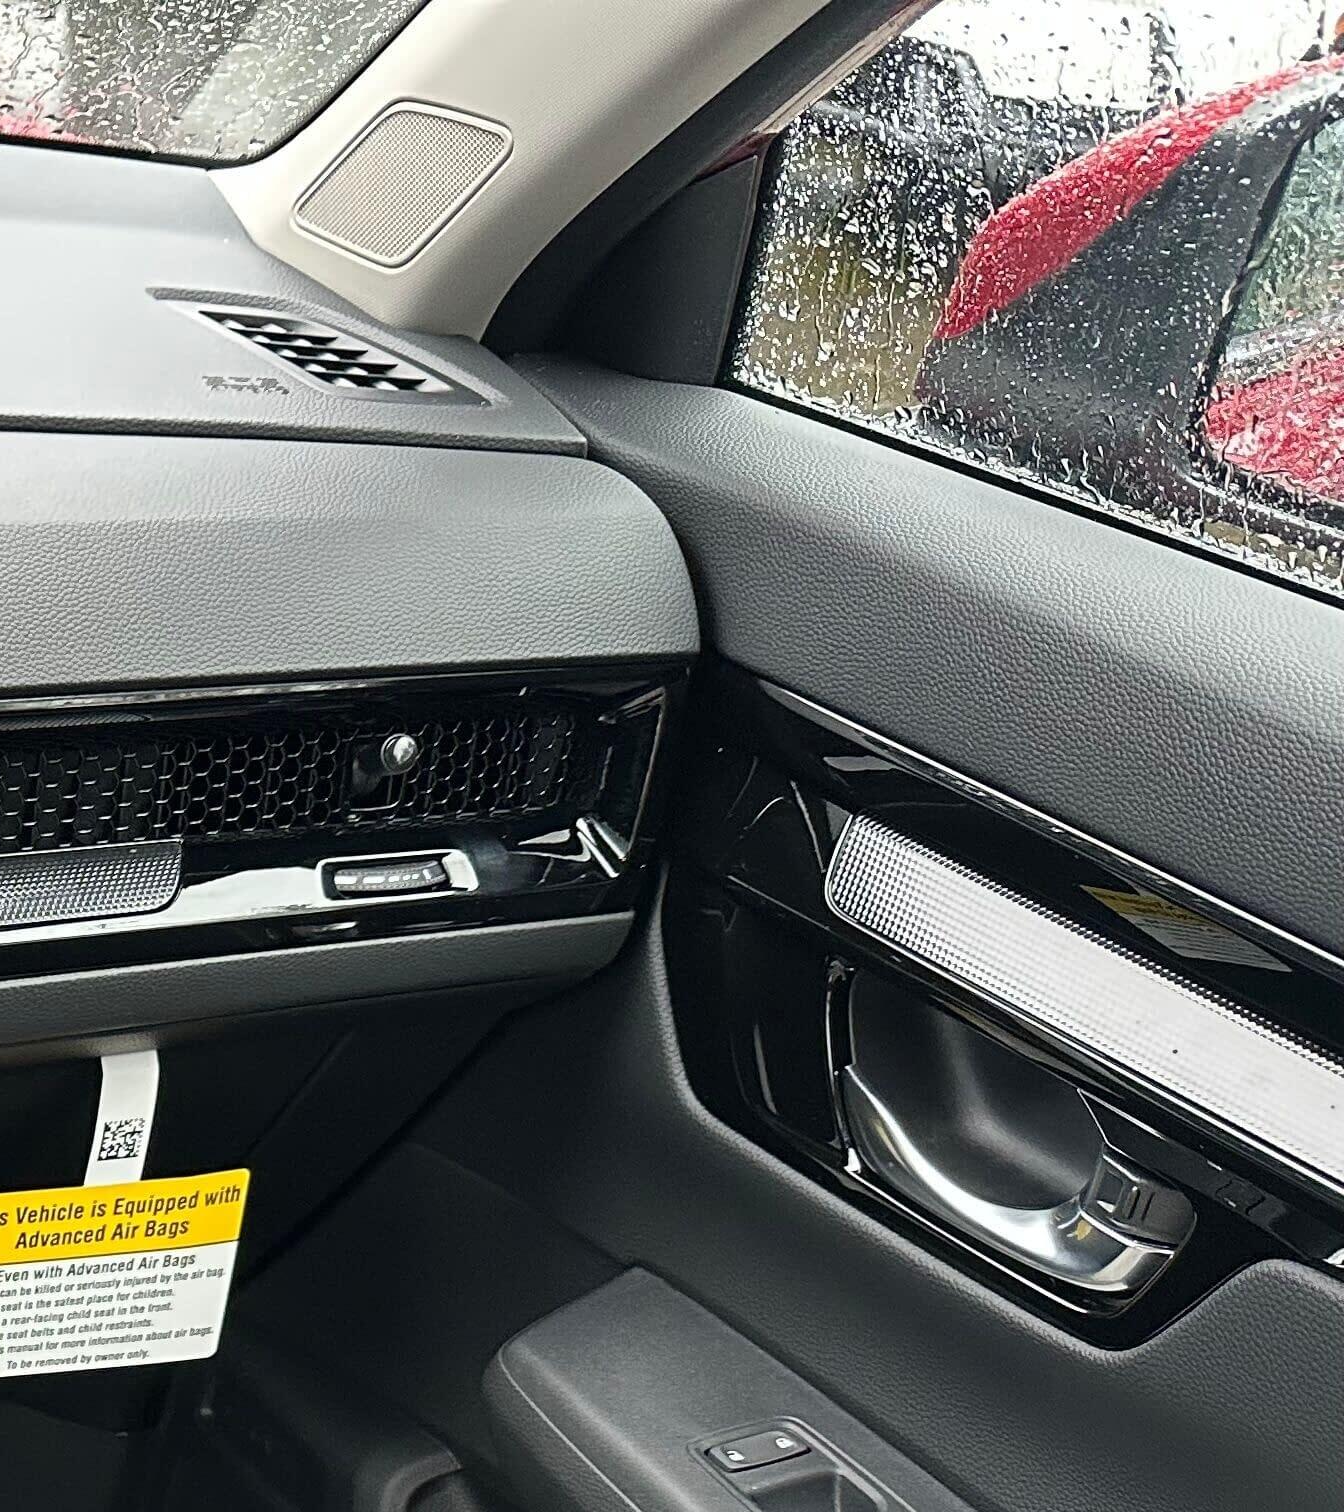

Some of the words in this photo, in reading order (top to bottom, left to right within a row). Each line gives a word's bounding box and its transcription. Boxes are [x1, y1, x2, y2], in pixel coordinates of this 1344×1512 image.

[16, 1203, 84, 1225] Vehicle
[90, 1201, 106, 1218] is
[113, 1191, 200, 1218] Equipped
[204, 1185, 241, 1206] with
[14, 1225, 105, 1249] Advanced
[112, 1222, 140, 1241] Air
[144, 1218, 190, 1241] Bags
[34, 1265, 63, 1279] with
[66, 1258, 134, 1276] Advanced
[138, 1257, 159, 1270] Air
[162, 1255, 196, 1268] Bags
